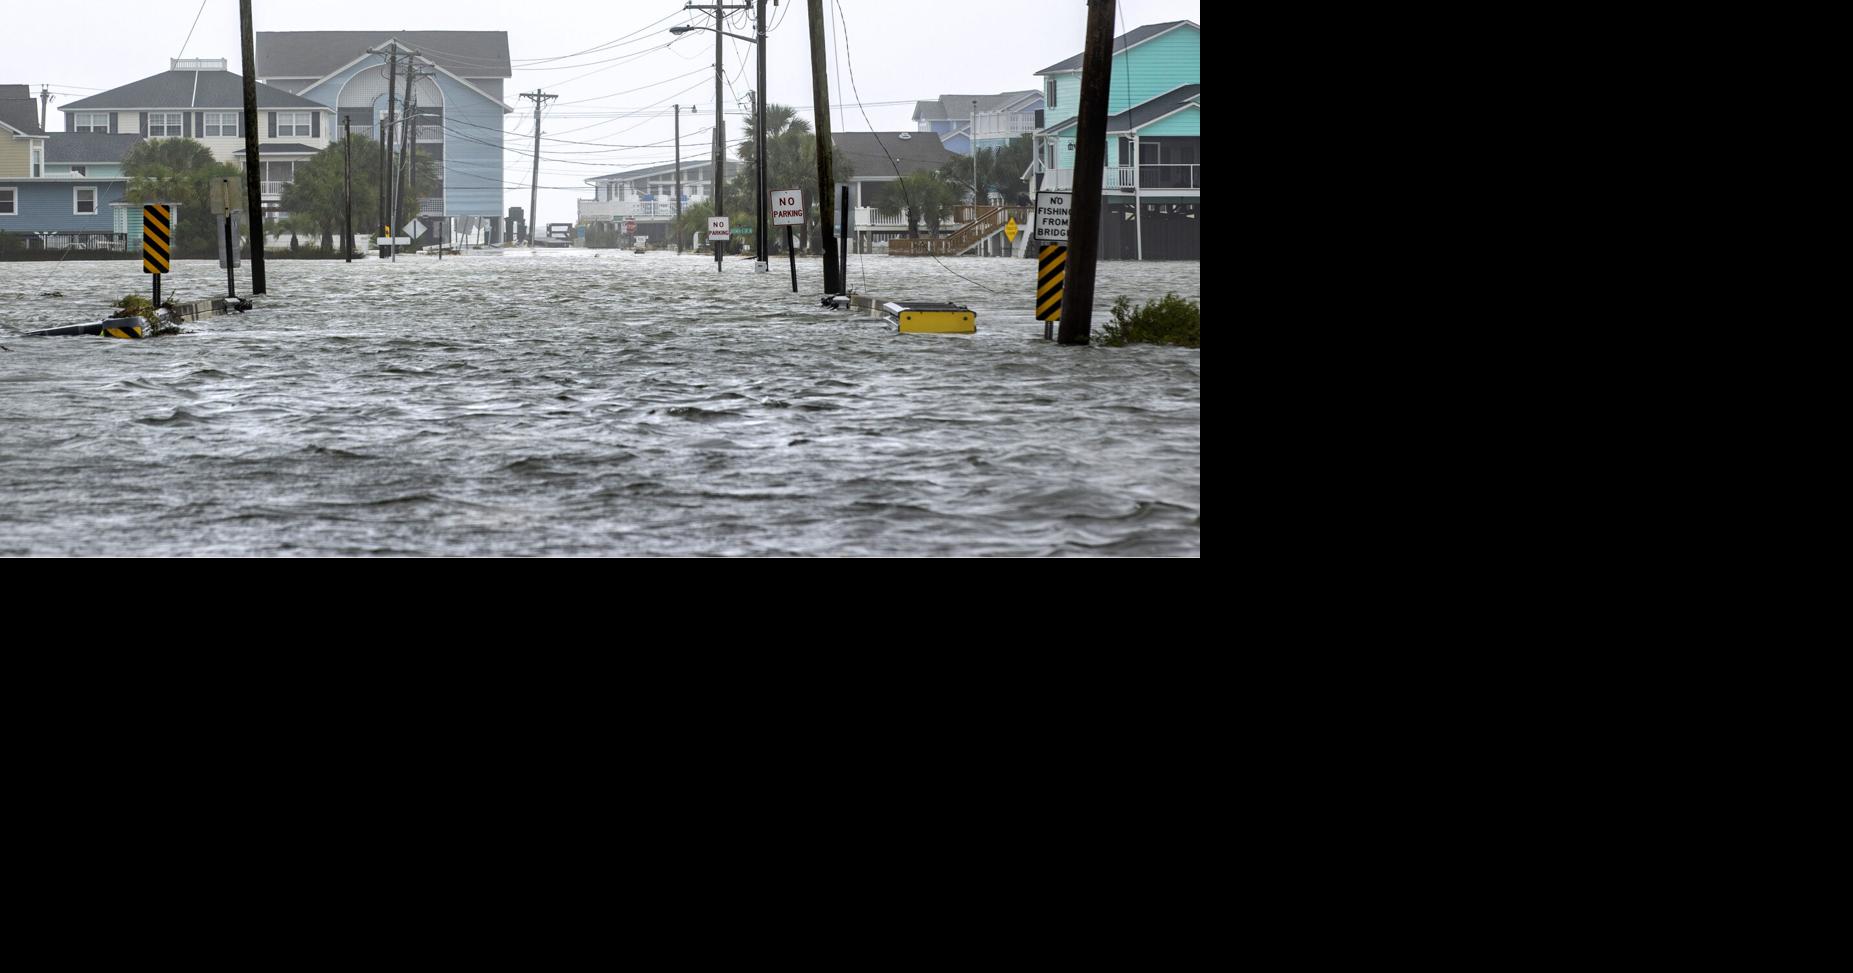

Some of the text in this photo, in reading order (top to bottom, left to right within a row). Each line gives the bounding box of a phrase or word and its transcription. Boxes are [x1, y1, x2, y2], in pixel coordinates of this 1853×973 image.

[779, 197, 795, 206] NO
[1050, 197, 1063, 205] NO
[773, 209, 803, 218] PARKING
[1042, 218, 1068, 226] FROM
